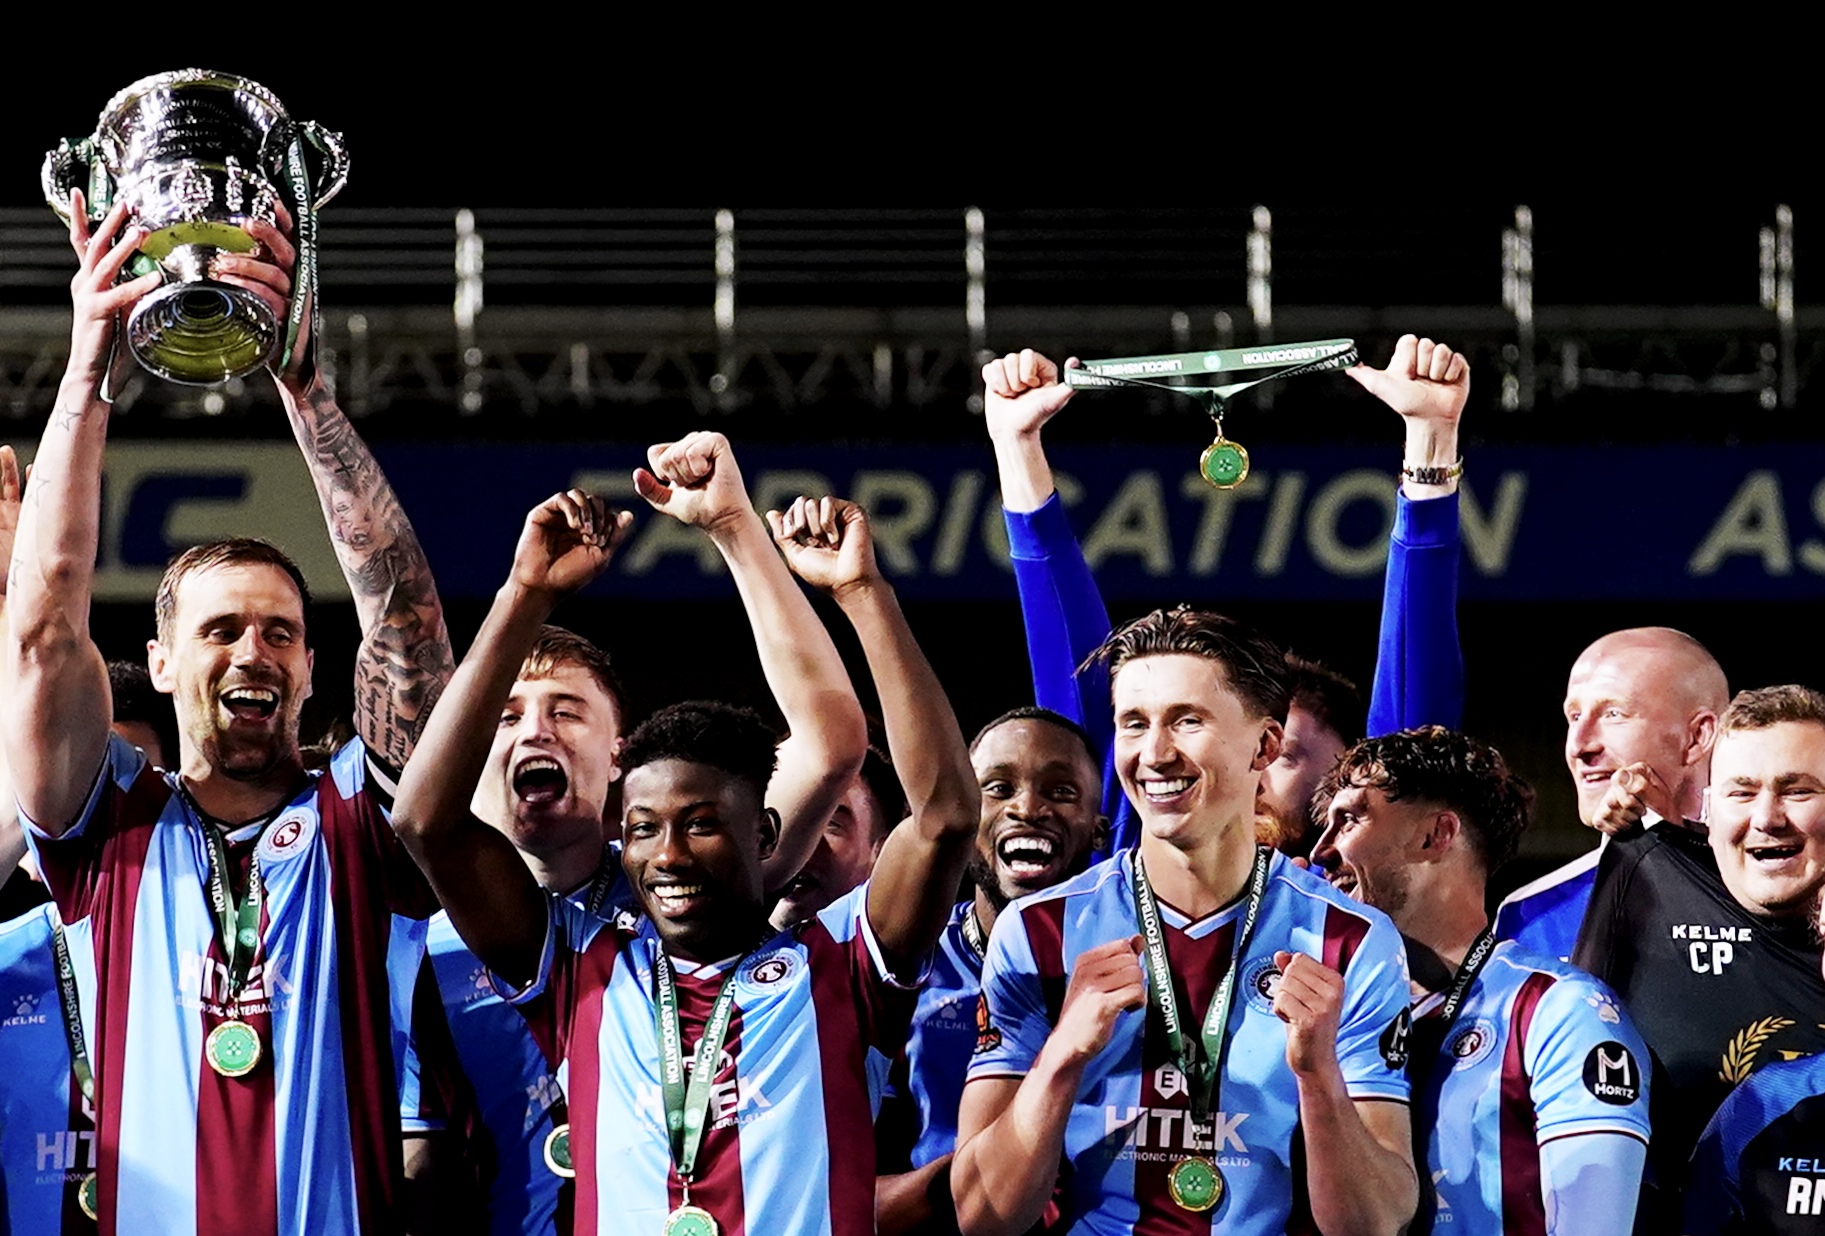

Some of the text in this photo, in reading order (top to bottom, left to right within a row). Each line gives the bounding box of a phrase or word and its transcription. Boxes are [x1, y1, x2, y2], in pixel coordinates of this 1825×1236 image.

[291, 178, 309, 237] FOOTBALL
[293, 238, 310, 324] ASSOCIATION
[1138, 883, 1159, 945] FOOTBALL
[1672, 925, 1752, 941] KELME
[1150, 945, 1176, 1034] LINCOLNSHIRE
[1689, 942, 1733, 975] CP
[64, 980, 86, 1058] LINCOLNSHIRE
[660, 1004, 679, 1084] ASSOCIATION
[696, 998, 731, 1083] LINCOLNSHIRE
[635, 1070, 772, 1120] HEK
[1105, 1105, 1251, 1154] HITEK
